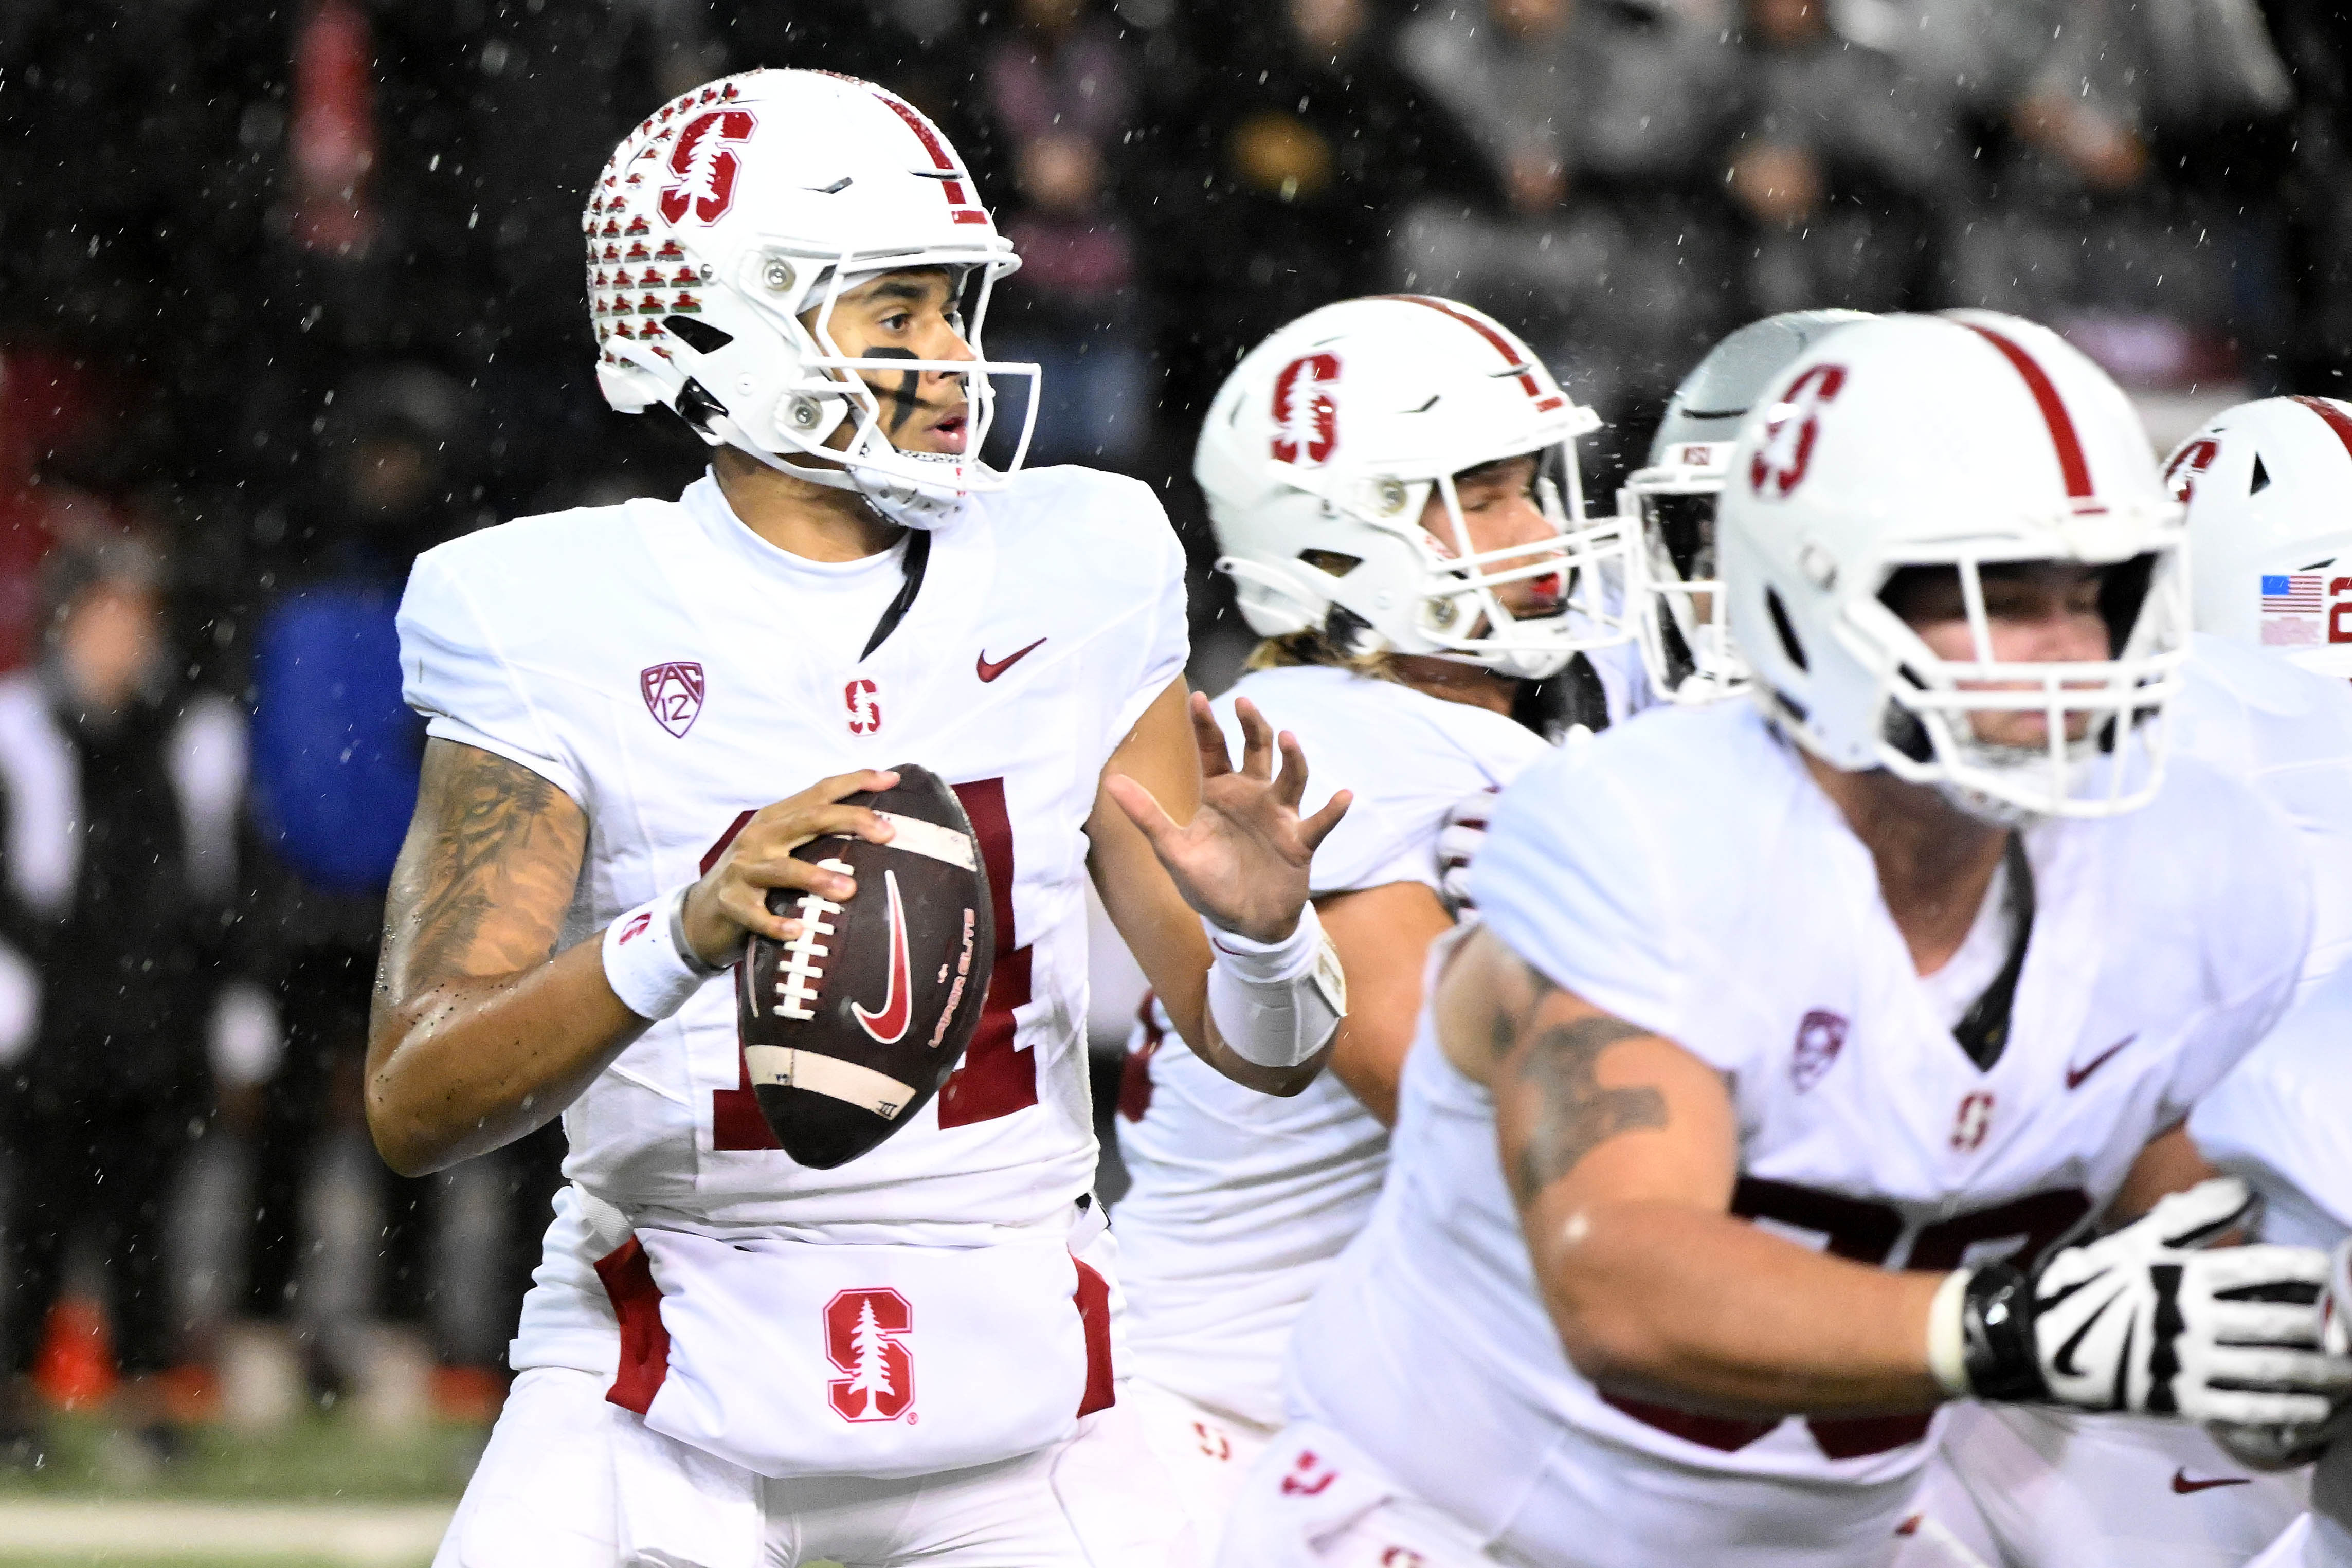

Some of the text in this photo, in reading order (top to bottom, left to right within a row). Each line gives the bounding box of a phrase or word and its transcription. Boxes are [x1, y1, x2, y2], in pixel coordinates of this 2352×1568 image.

[642, 665, 703, 709] PAC
[662, 694, 691, 721] 12
[823, 1287, 915, 1423] S
